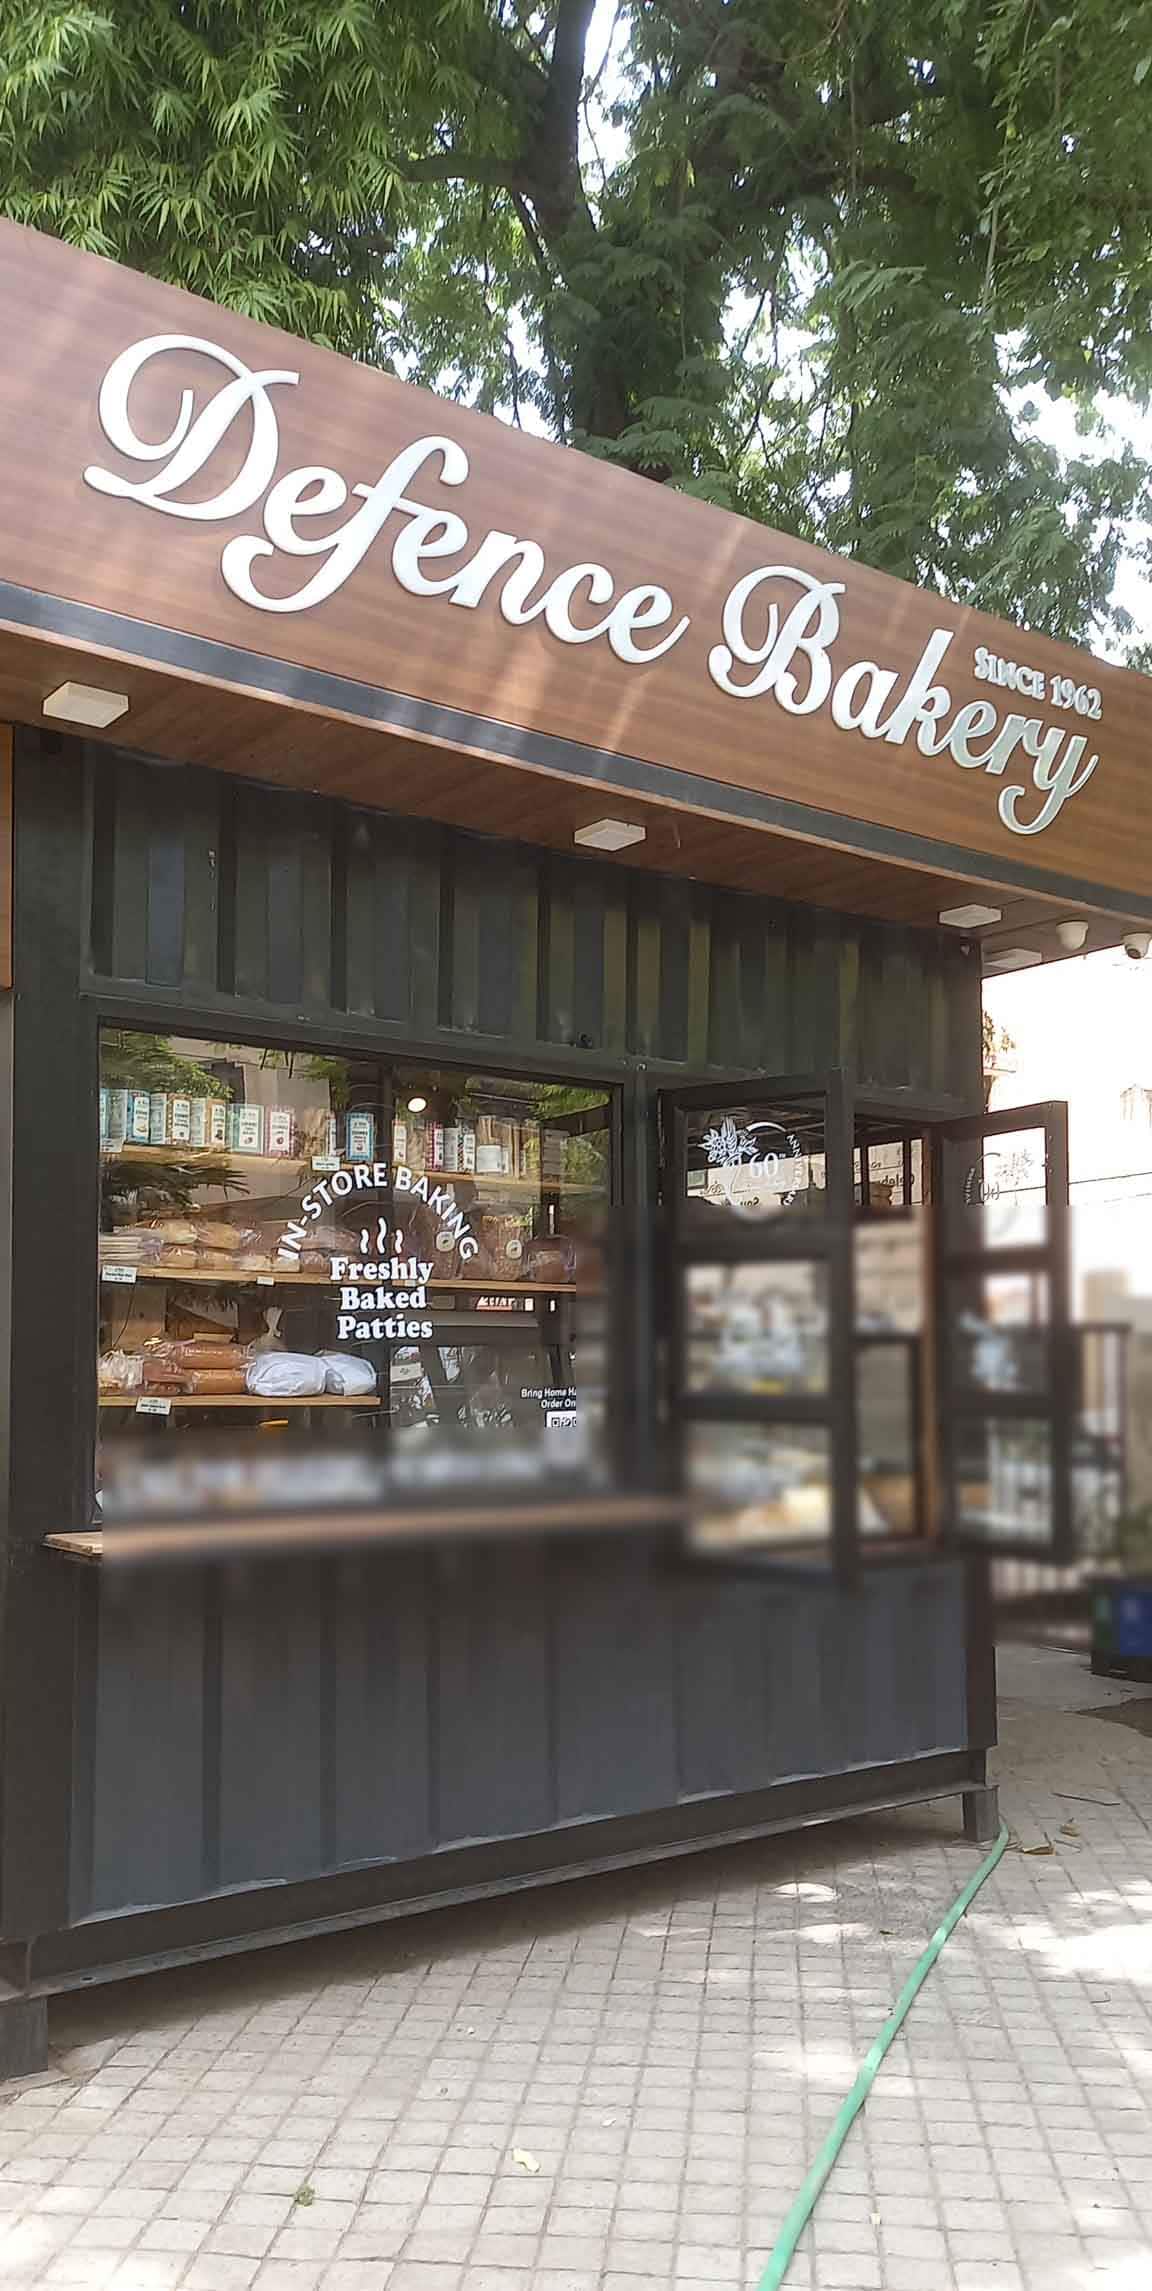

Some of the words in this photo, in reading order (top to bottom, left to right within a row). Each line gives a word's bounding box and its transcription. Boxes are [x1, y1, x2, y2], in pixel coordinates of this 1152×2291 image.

[83, 334, 690, 664] Defence
[708, 565, 1099, 835] Bakery
[974, 646, 1046, 699] SINCE
[1050, 674, 1103, 720] 1962
[278, 1163, 389, 1261] IN-STORE
[395, 1165, 479, 1260] BAKING
[330, 1256, 434, 1284] Freshly
[340, 1286, 427, 1311] Baked
[337, 1313, 433, 1340] Patties
[521, 1388, 543, 1399] Bring
[544, 1388, 566, 1397] Home
[541, 1400, 562, 1408] Order
